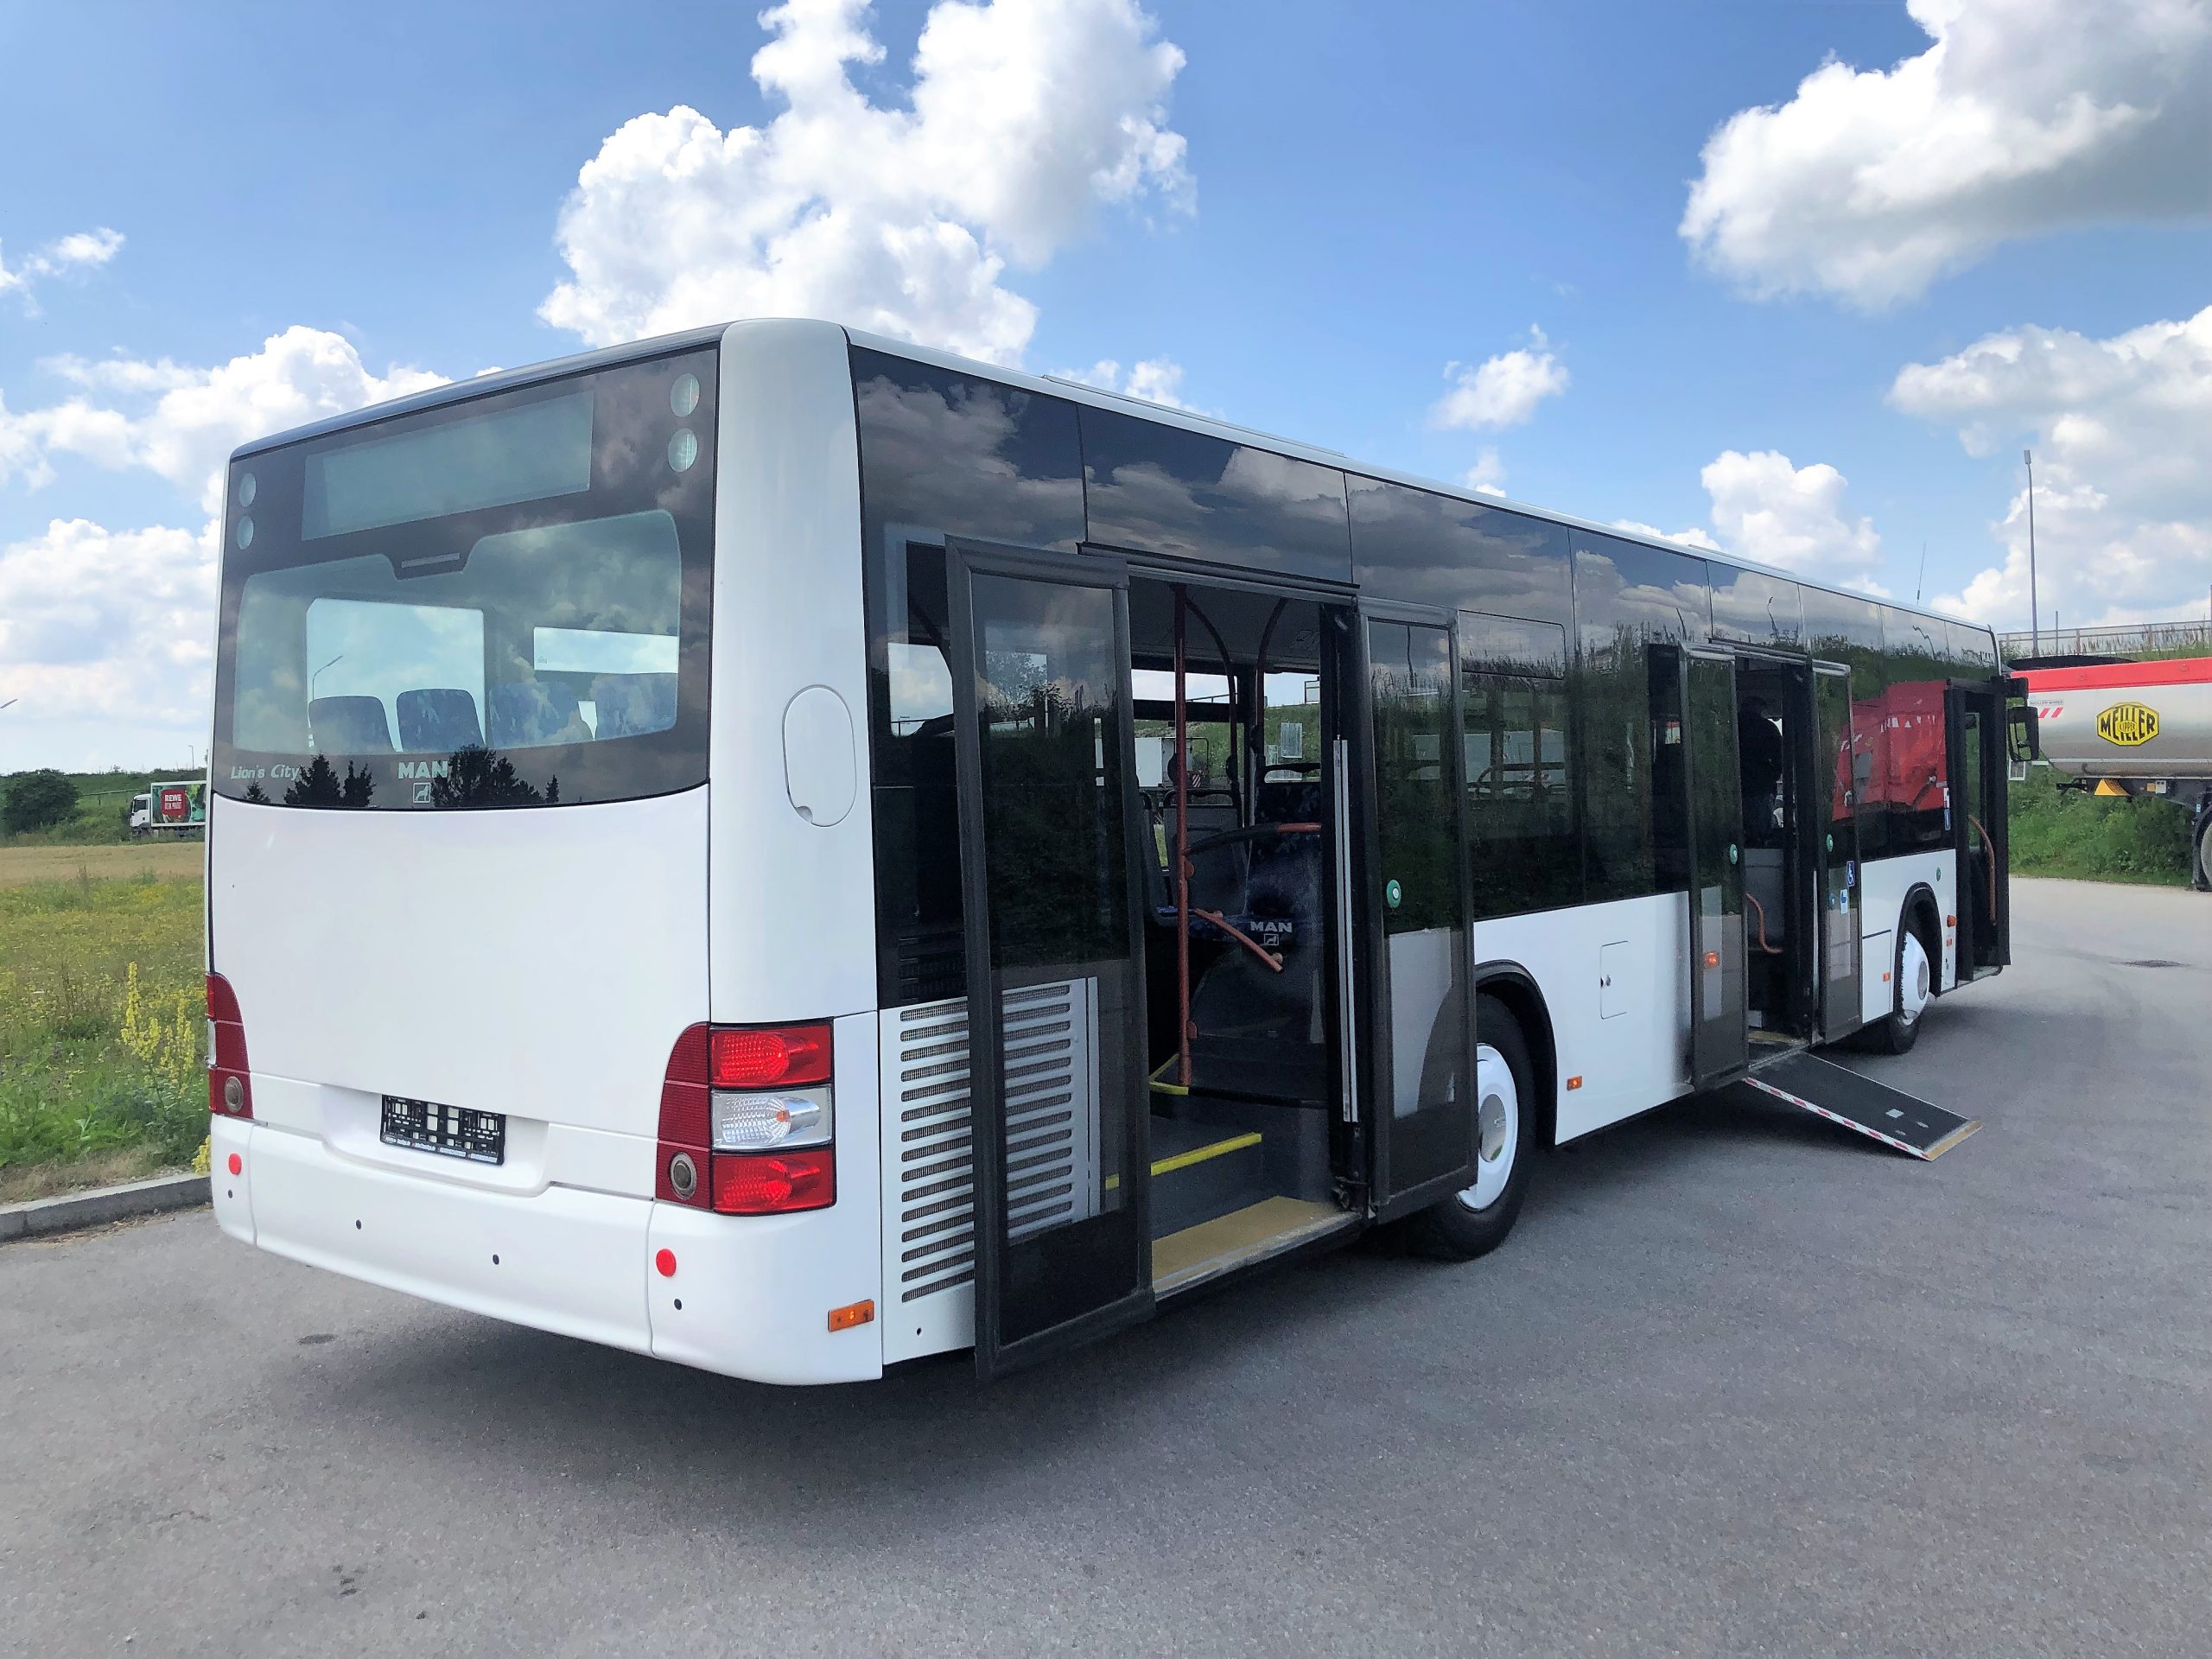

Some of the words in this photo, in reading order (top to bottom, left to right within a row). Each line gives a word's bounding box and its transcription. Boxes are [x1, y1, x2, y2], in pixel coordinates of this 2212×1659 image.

[2101, 705, 2156, 741] MEILLER
[231, 765, 265, 779] Lion's
[270, 764, 301, 781] City
[398, 761, 448, 779] MAN
[1250, 921, 1293, 932] MAN
